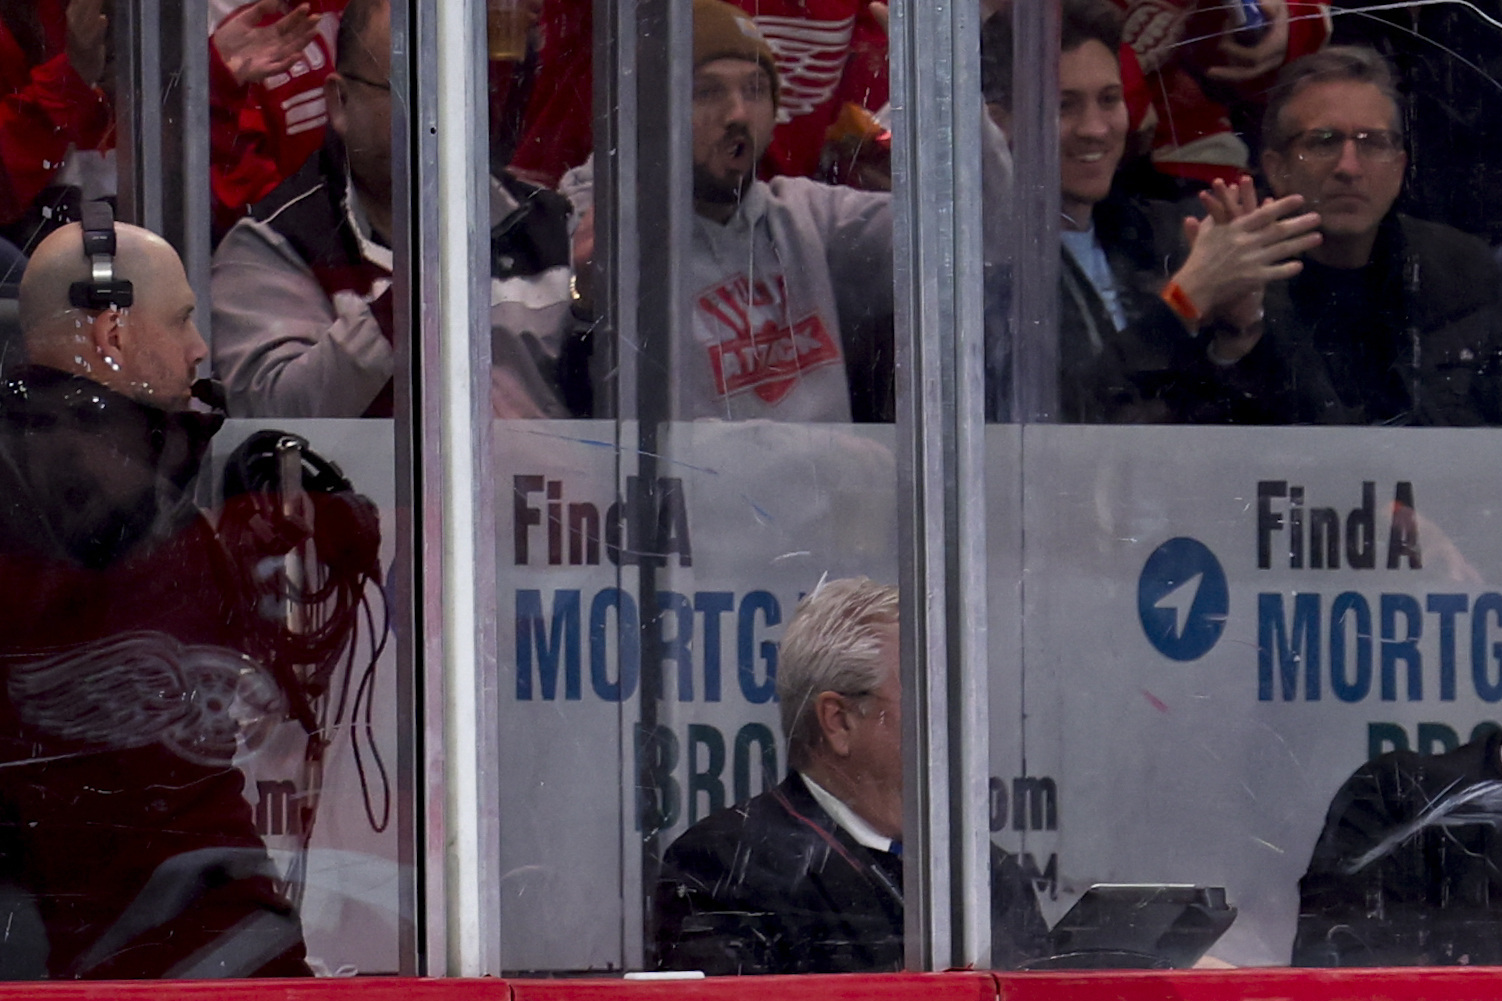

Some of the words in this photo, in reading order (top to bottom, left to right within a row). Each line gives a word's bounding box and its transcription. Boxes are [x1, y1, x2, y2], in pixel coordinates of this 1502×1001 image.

[513, 474, 642, 567] Find
[1257, 480, 1376, 571] Find
[1386, 481, 1423, 570] A
[515, 586, 806, 703] MORTG
